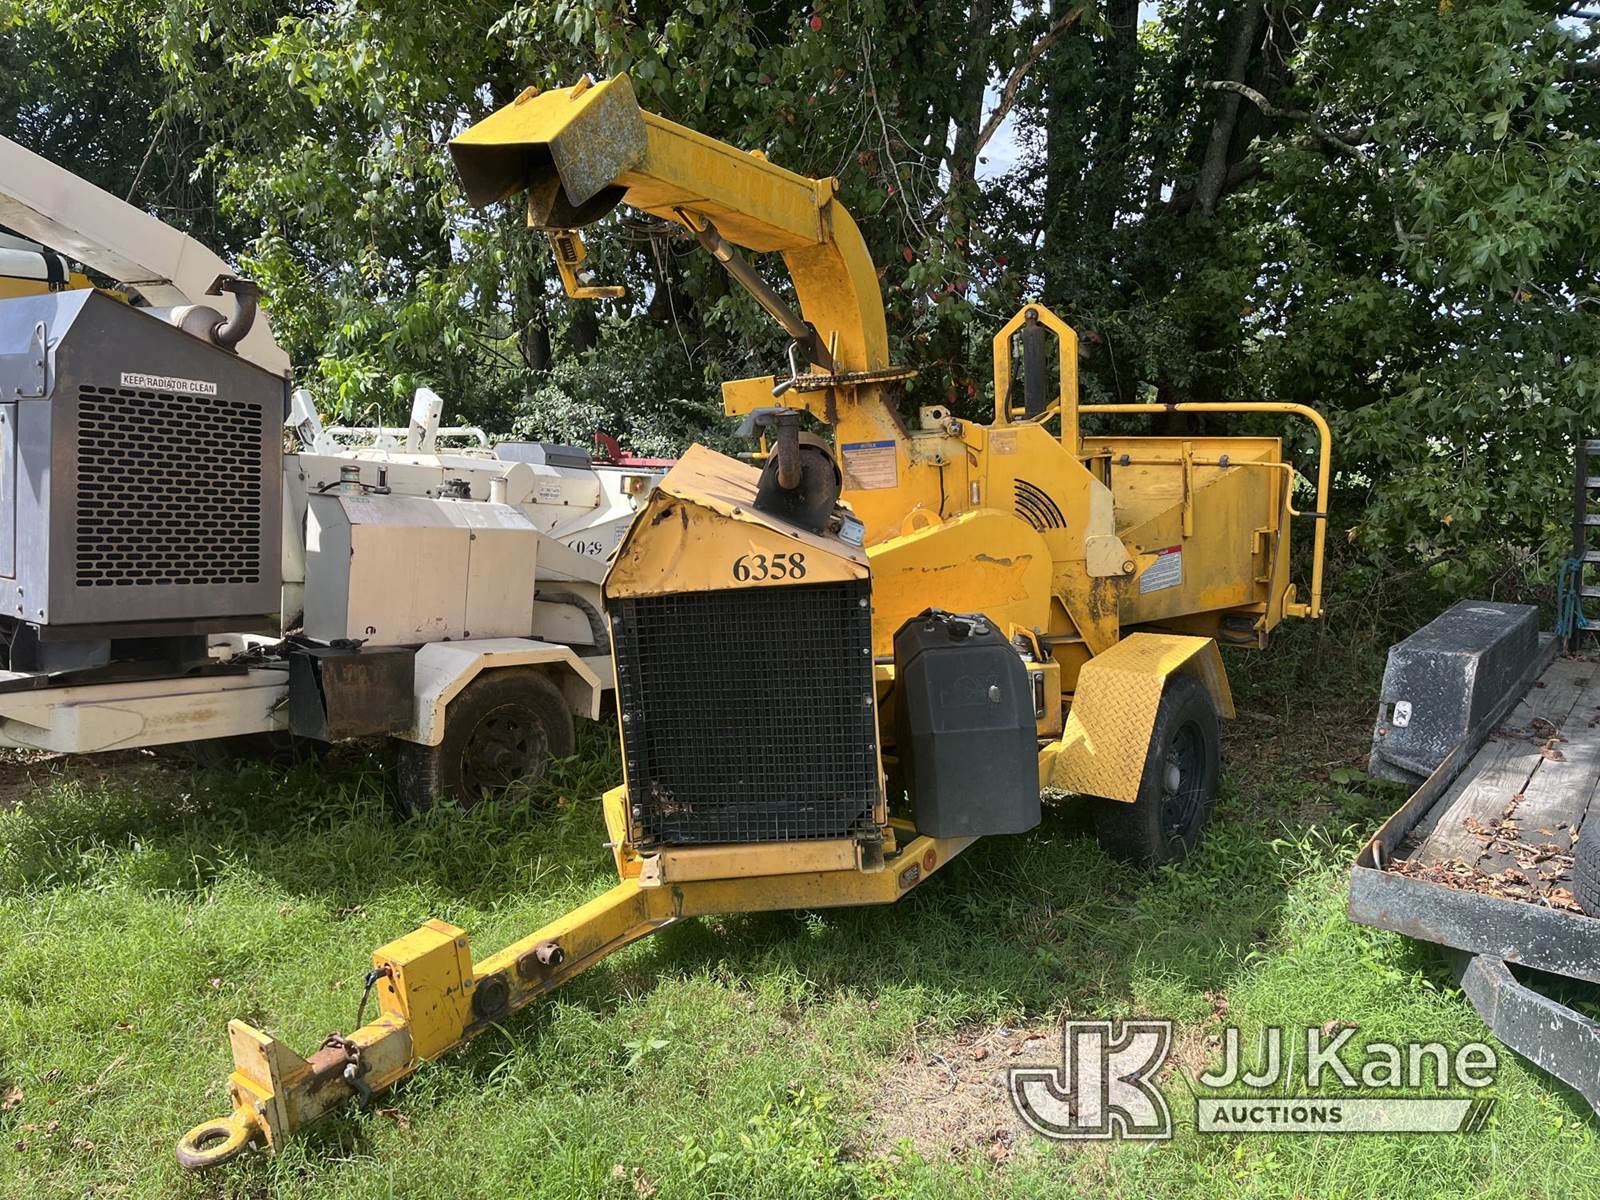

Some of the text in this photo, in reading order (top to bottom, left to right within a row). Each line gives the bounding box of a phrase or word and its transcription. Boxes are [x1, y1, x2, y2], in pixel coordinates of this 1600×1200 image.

[123, 375, 214, 393] KEEP RADIATOR CLEAN
[733, 552, 806, 582] 6358
